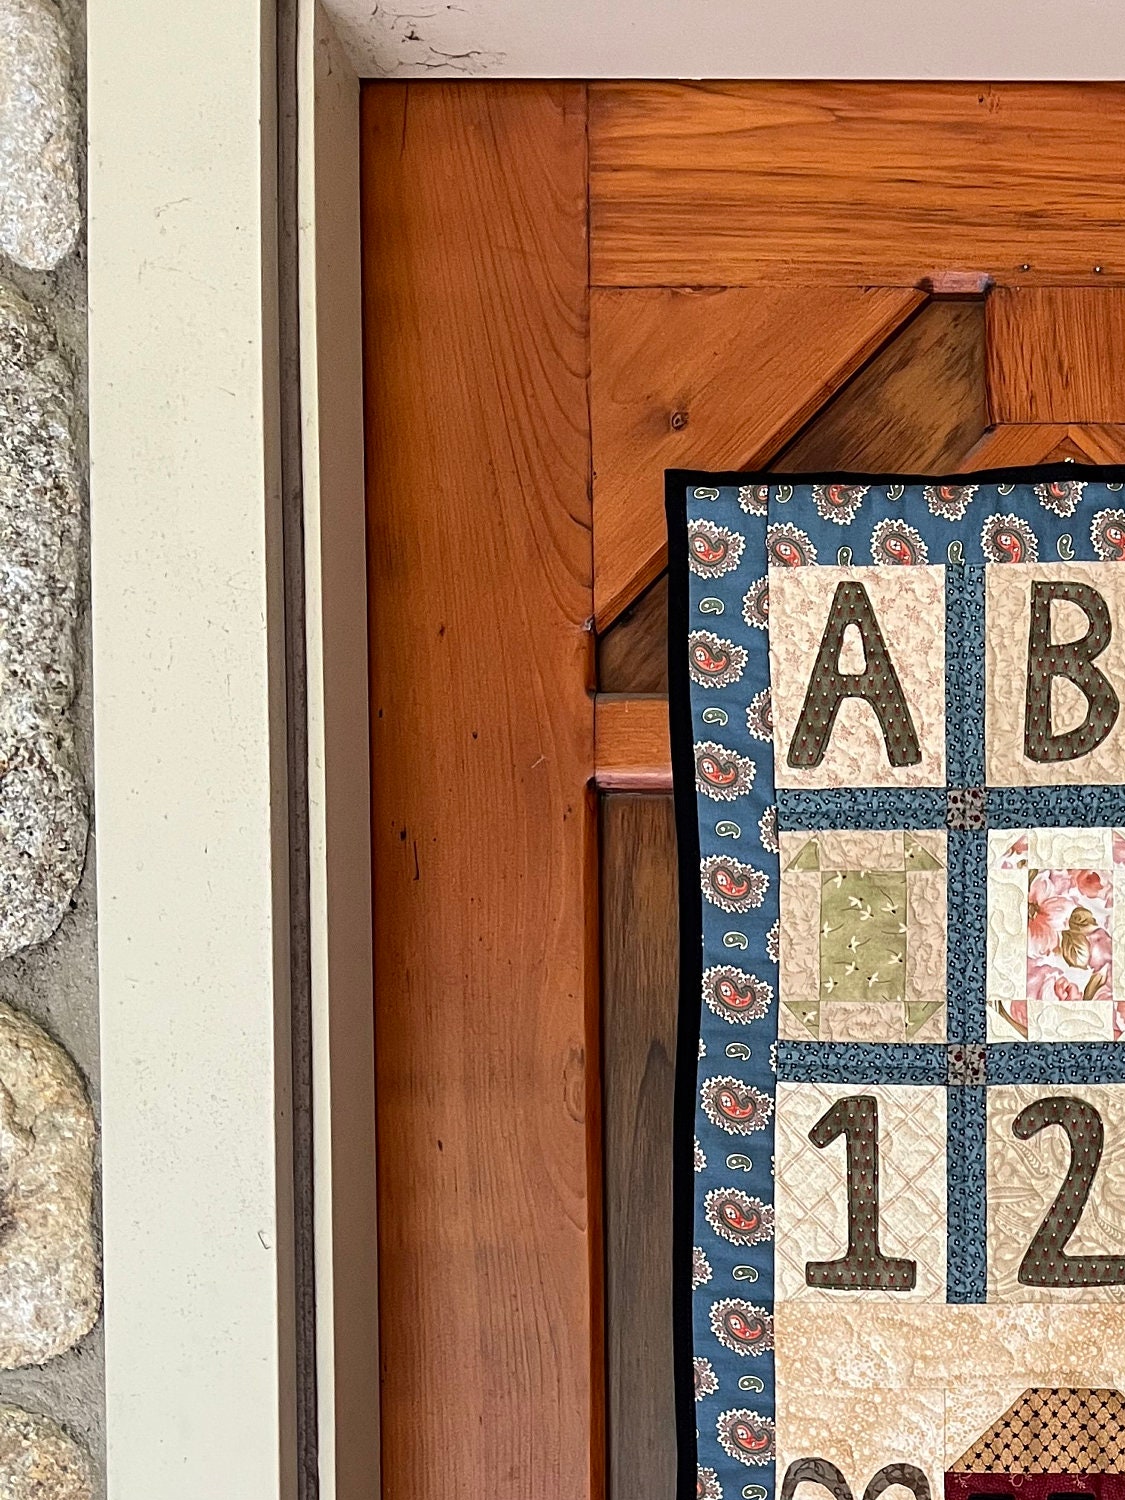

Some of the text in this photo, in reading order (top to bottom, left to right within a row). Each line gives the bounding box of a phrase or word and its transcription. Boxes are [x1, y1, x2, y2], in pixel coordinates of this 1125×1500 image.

[788, 581, 922, 768] A
[1024, 581, 1119, 762] B
[805, 1096, 916, 1290] 1
